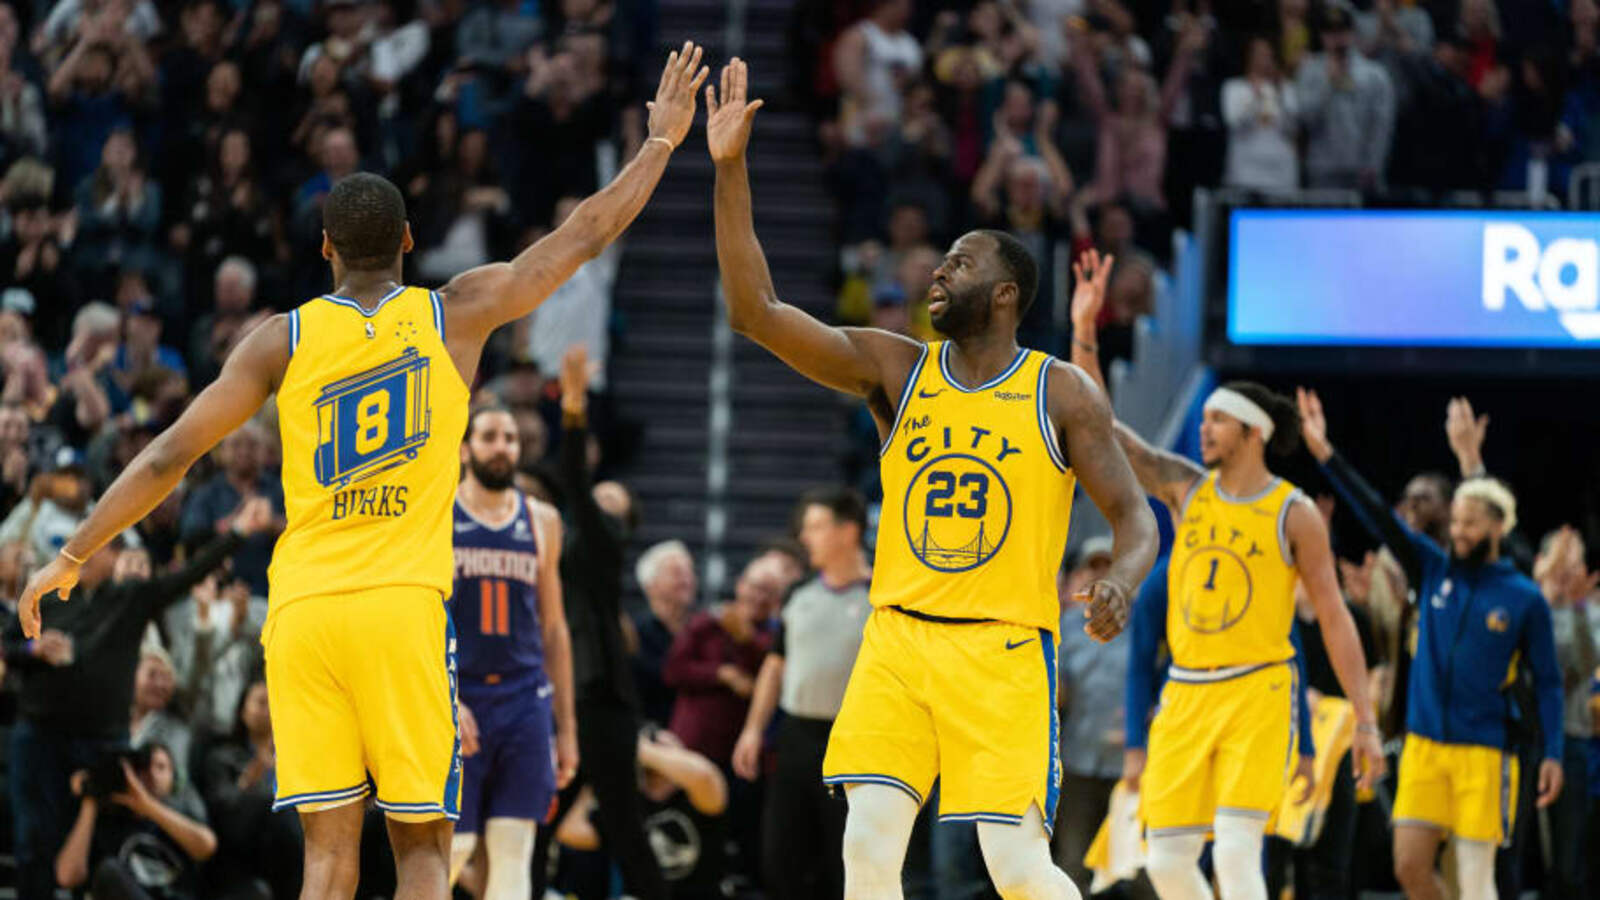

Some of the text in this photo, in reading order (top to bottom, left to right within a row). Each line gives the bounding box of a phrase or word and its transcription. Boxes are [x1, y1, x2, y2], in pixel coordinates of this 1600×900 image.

[356, 389, 390, 455] 8
[906, 427, 1021, 462] CITY
[332, 486, 408, 519] BURKS
[925, 472, 989, 518] 23
[1185, 526, 1263, 558] CITY
[1204, 558, 1219, 590] 1
[480, 580, 508, 634] 11
